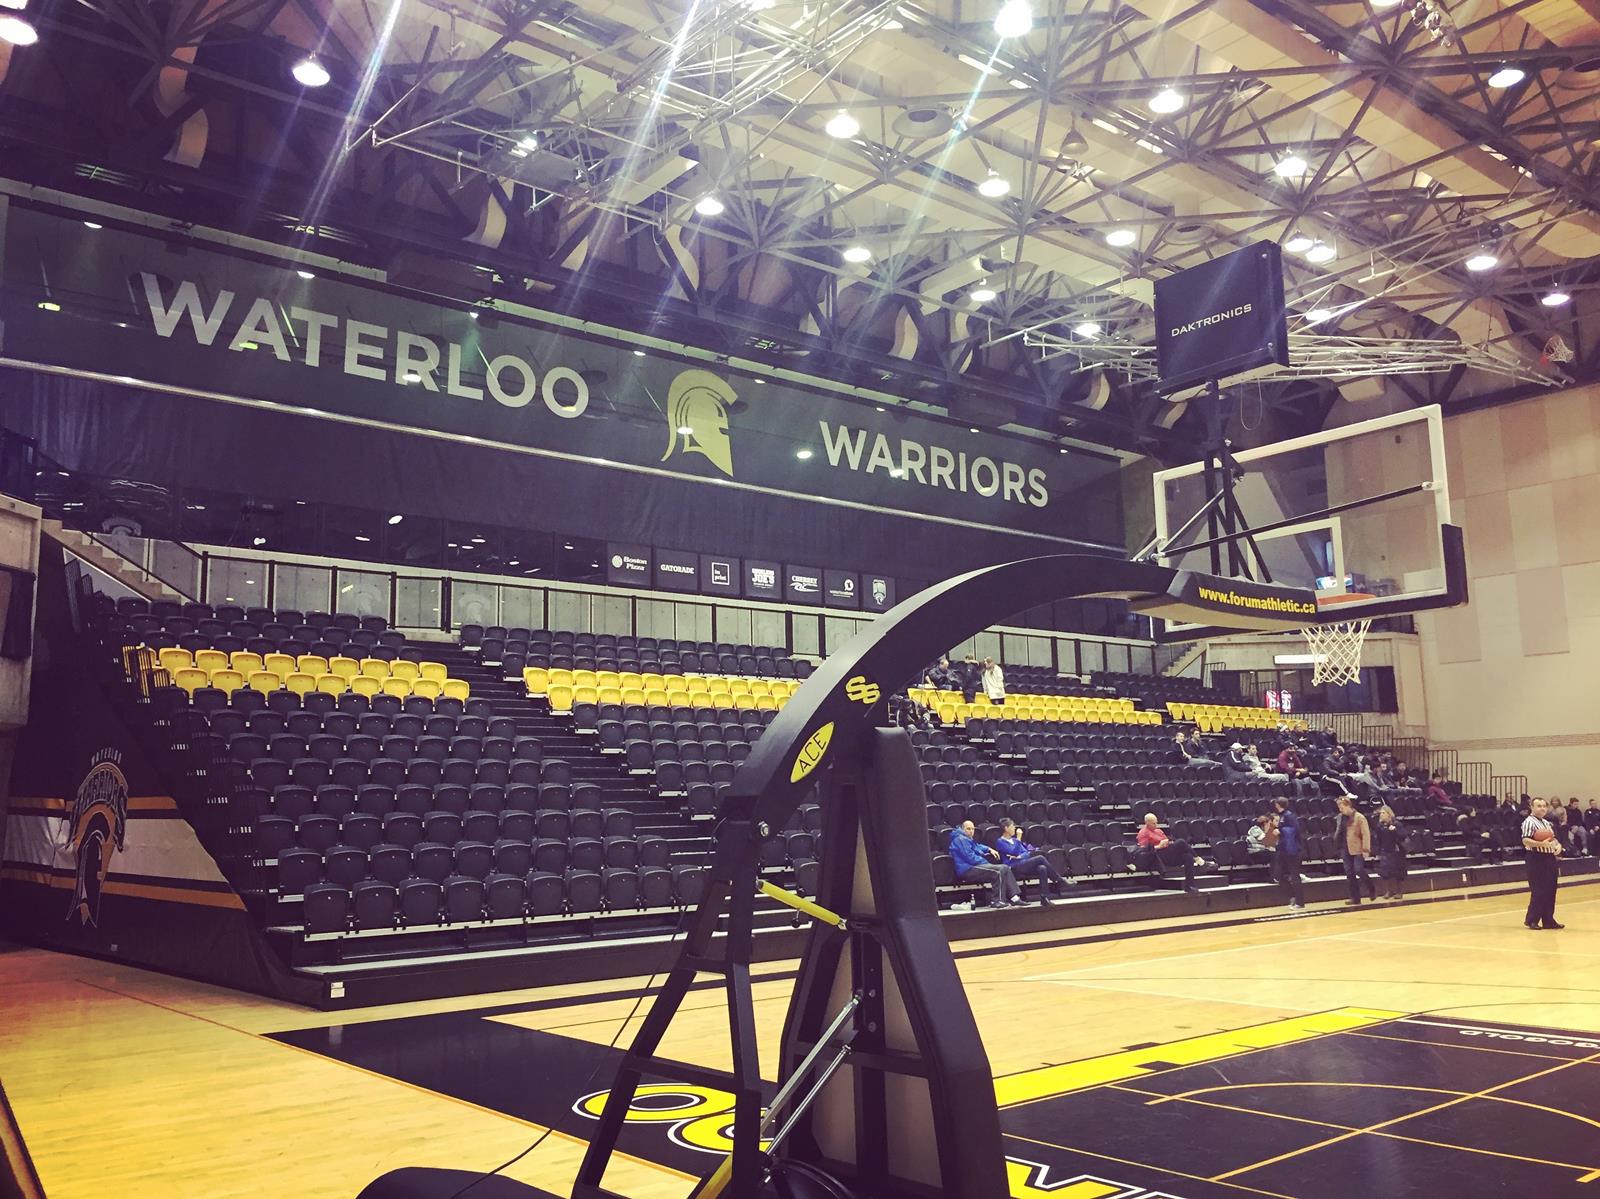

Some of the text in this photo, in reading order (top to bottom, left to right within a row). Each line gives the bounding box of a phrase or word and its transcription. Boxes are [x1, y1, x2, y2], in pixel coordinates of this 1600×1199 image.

[1171, 303, 1252, 337] DAKTRONICS
[140, 272, 589, 419] WATERLOO
[819, 420, 1049, 508] WARRIORS
[623, 556, 647, 565] Boston
[660, 564, 695, 574] GATORADE
[1198, 586, 1316, 614] www.forumathletic.ca
[799, 732, 827, 773] ACE
